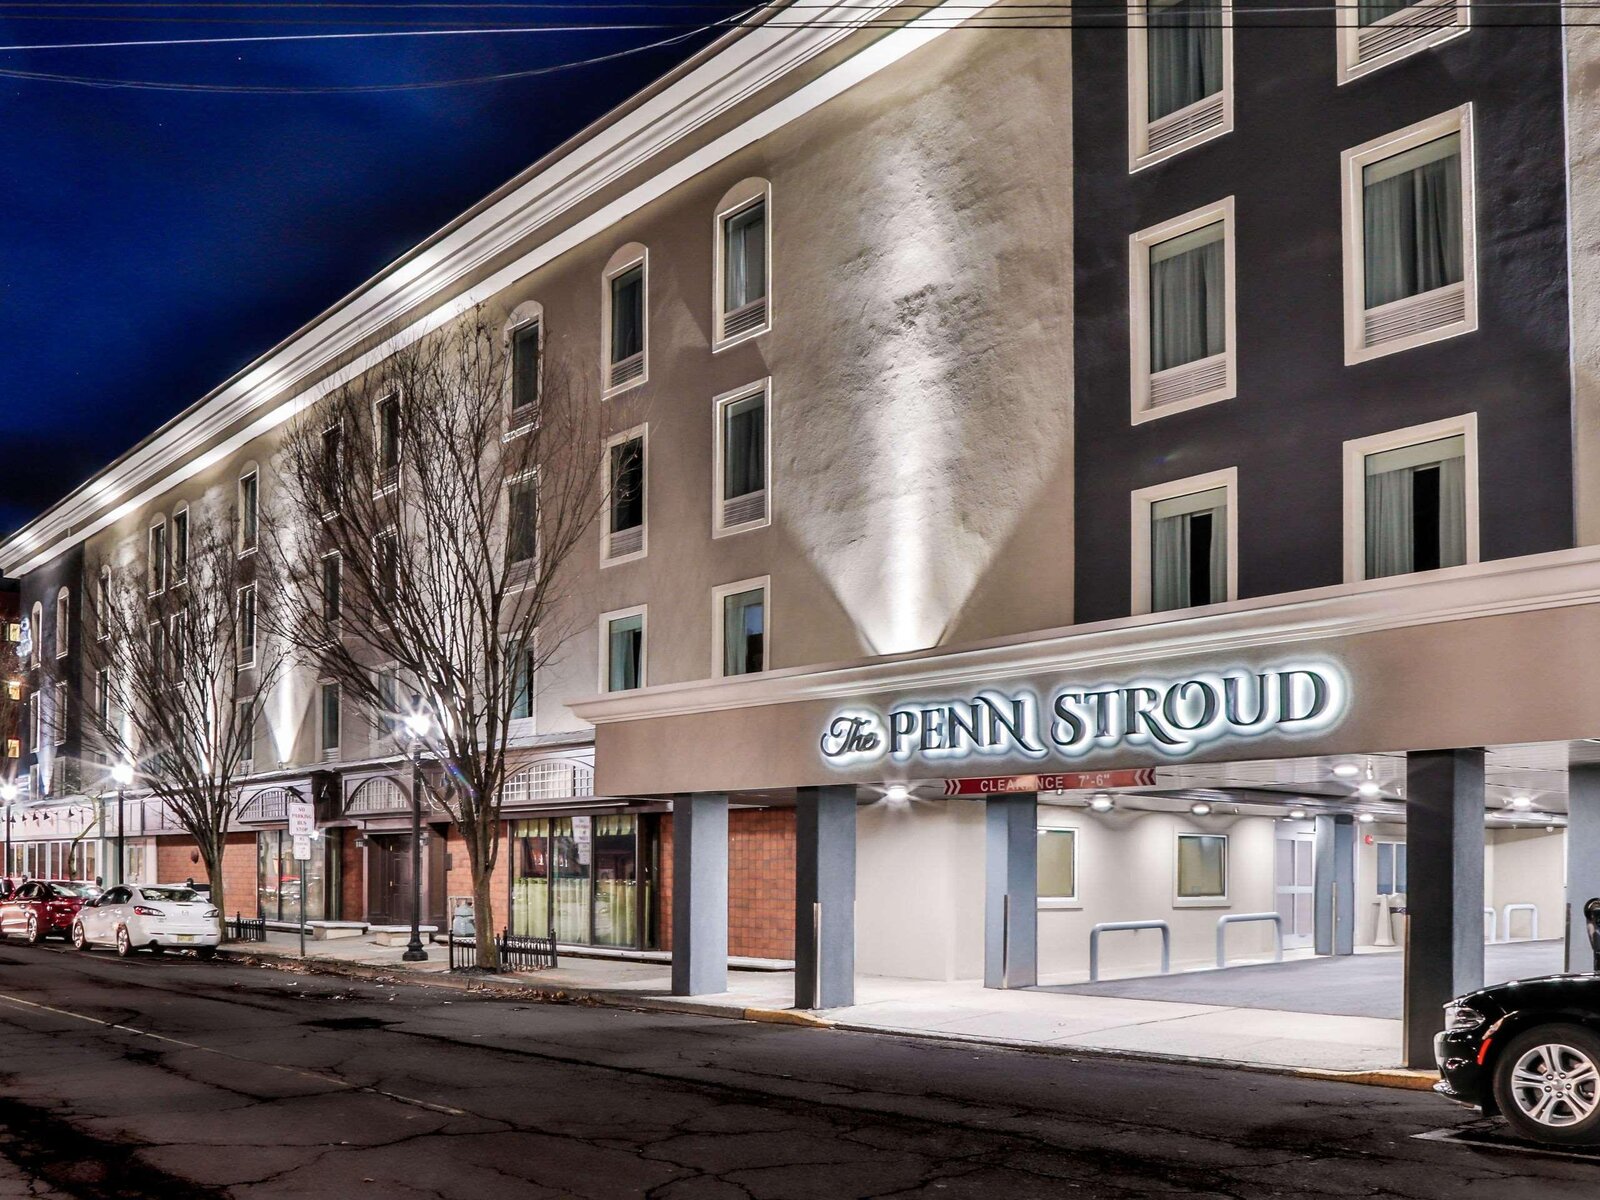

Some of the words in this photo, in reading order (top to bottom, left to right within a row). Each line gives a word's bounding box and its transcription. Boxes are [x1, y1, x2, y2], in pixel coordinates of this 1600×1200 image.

[821, 716, 882, 758] The
[888, 696, 1045, 753] PENN
[1050, 669, 1329, 746] STROUD
